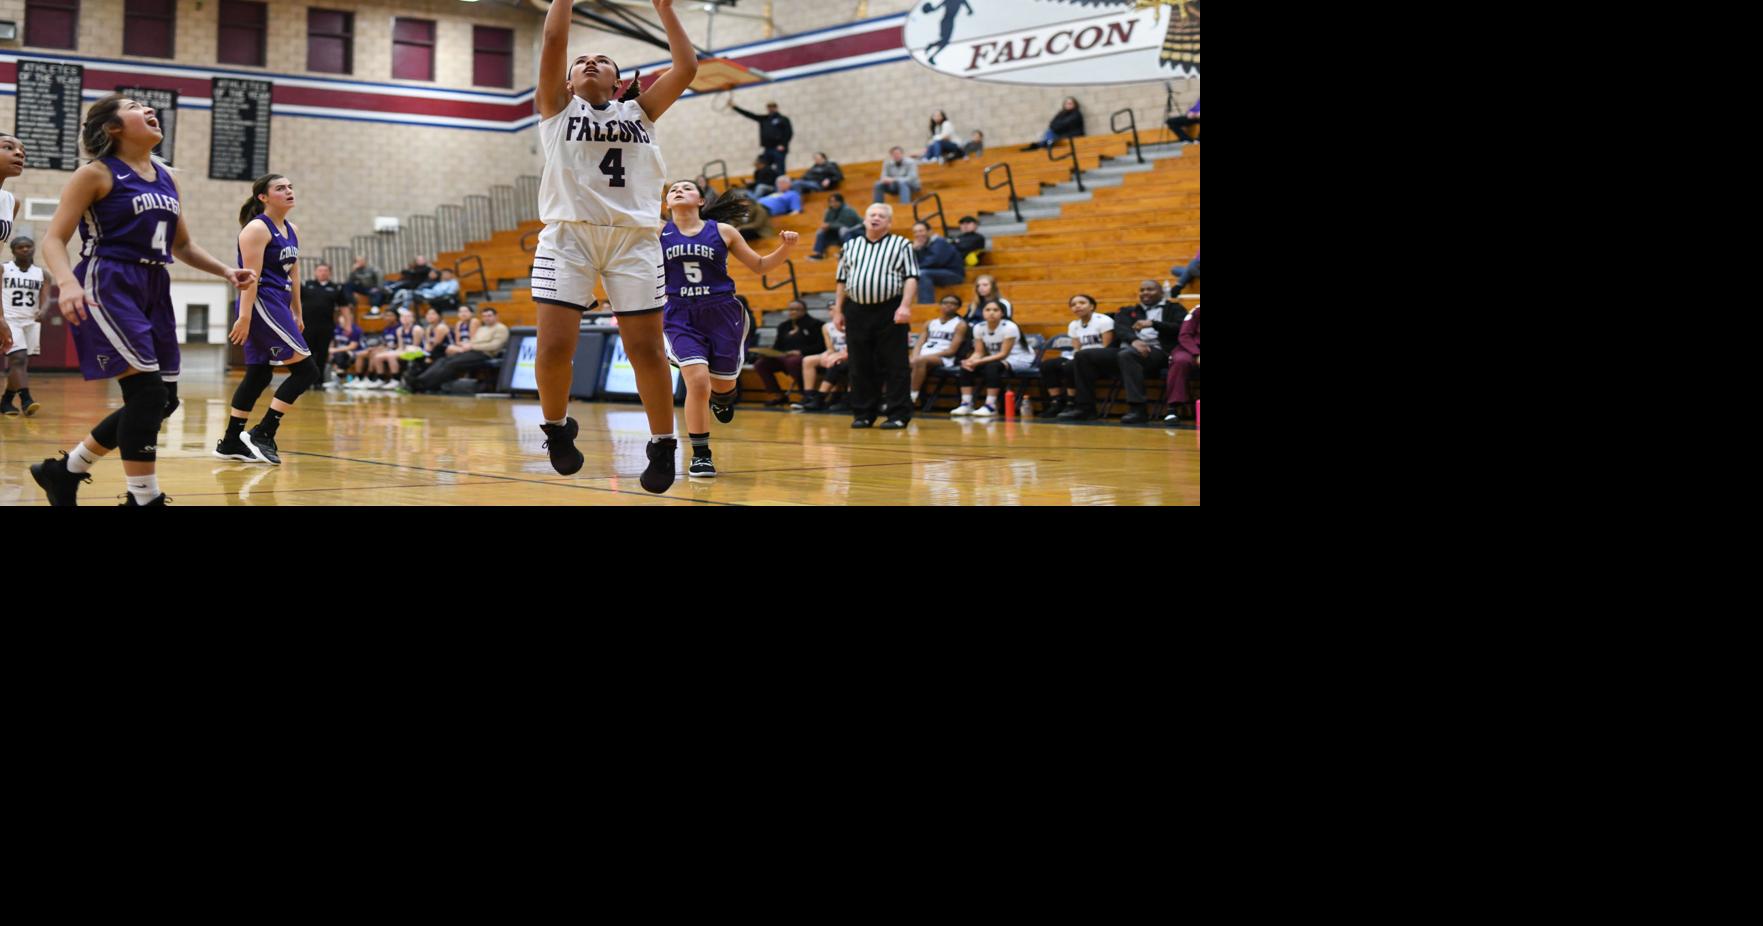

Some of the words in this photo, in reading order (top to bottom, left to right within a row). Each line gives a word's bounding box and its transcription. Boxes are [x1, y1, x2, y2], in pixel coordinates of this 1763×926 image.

[963, 18, 1140, 72] FALCON
[565, 115, 651, 144] FALCONS
[598, 147, 626, 188] 4
[131, 192, 181, 217] COLLEG
[151, 220, 168, 256] 4
[665, 243, 716, 261] COLLEGE
[682, 261, 703, 284] 5
[11, 290, 36, 307] 23
[680, 286, 711, 298] PARK
